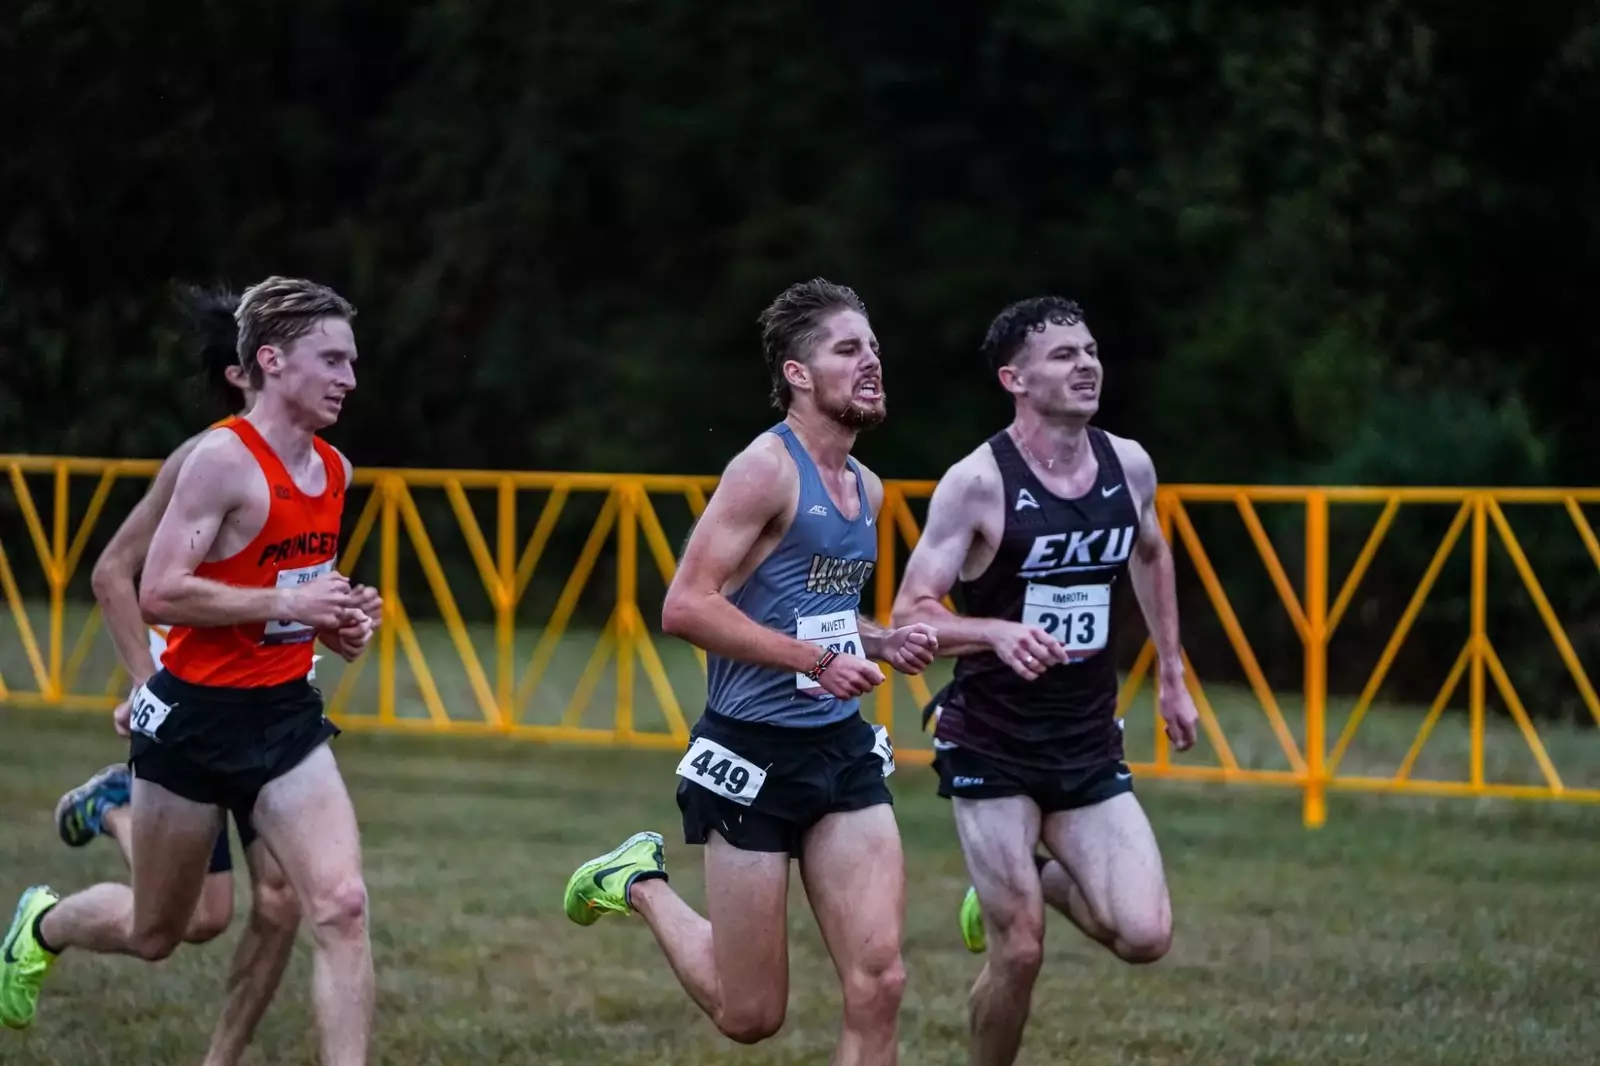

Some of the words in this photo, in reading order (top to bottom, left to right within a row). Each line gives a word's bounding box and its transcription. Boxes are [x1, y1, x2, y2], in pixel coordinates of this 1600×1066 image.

[808, 504, 828, 515] ACC
[1021, 526, 1135, 570] EKU
[821, 618, 846, 633] KIVETT
[1038, 612, 1095, 645] 213
[133, 692, 156, 729] 46
[690, 749, 751, 795] 449
